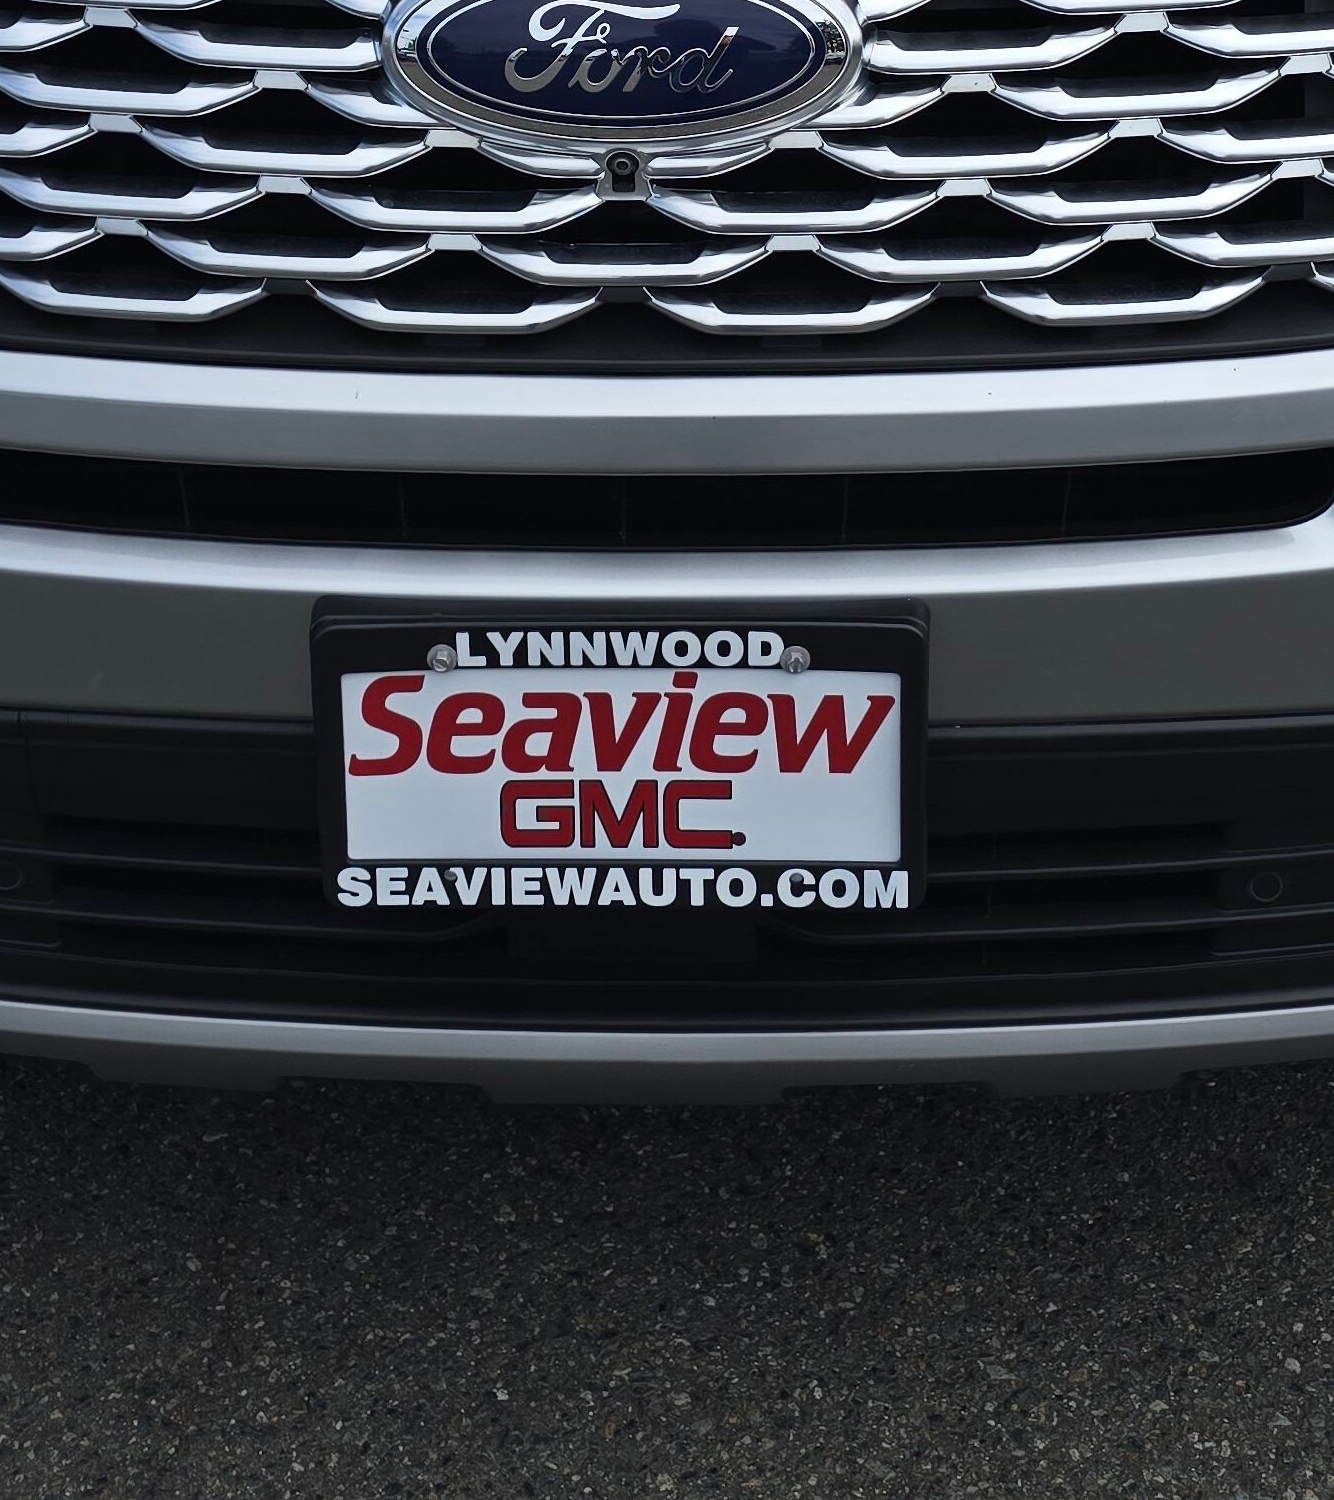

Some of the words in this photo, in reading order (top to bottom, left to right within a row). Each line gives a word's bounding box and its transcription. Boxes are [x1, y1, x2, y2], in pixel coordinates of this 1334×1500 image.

[454, 630, 785, 668] LYNNWOOD
[348, 671, 896, 777] Seaview
[499, 779, 734, 849] GMC
[336, 866, 909, 909] SEAVIEWAUTO.COM
